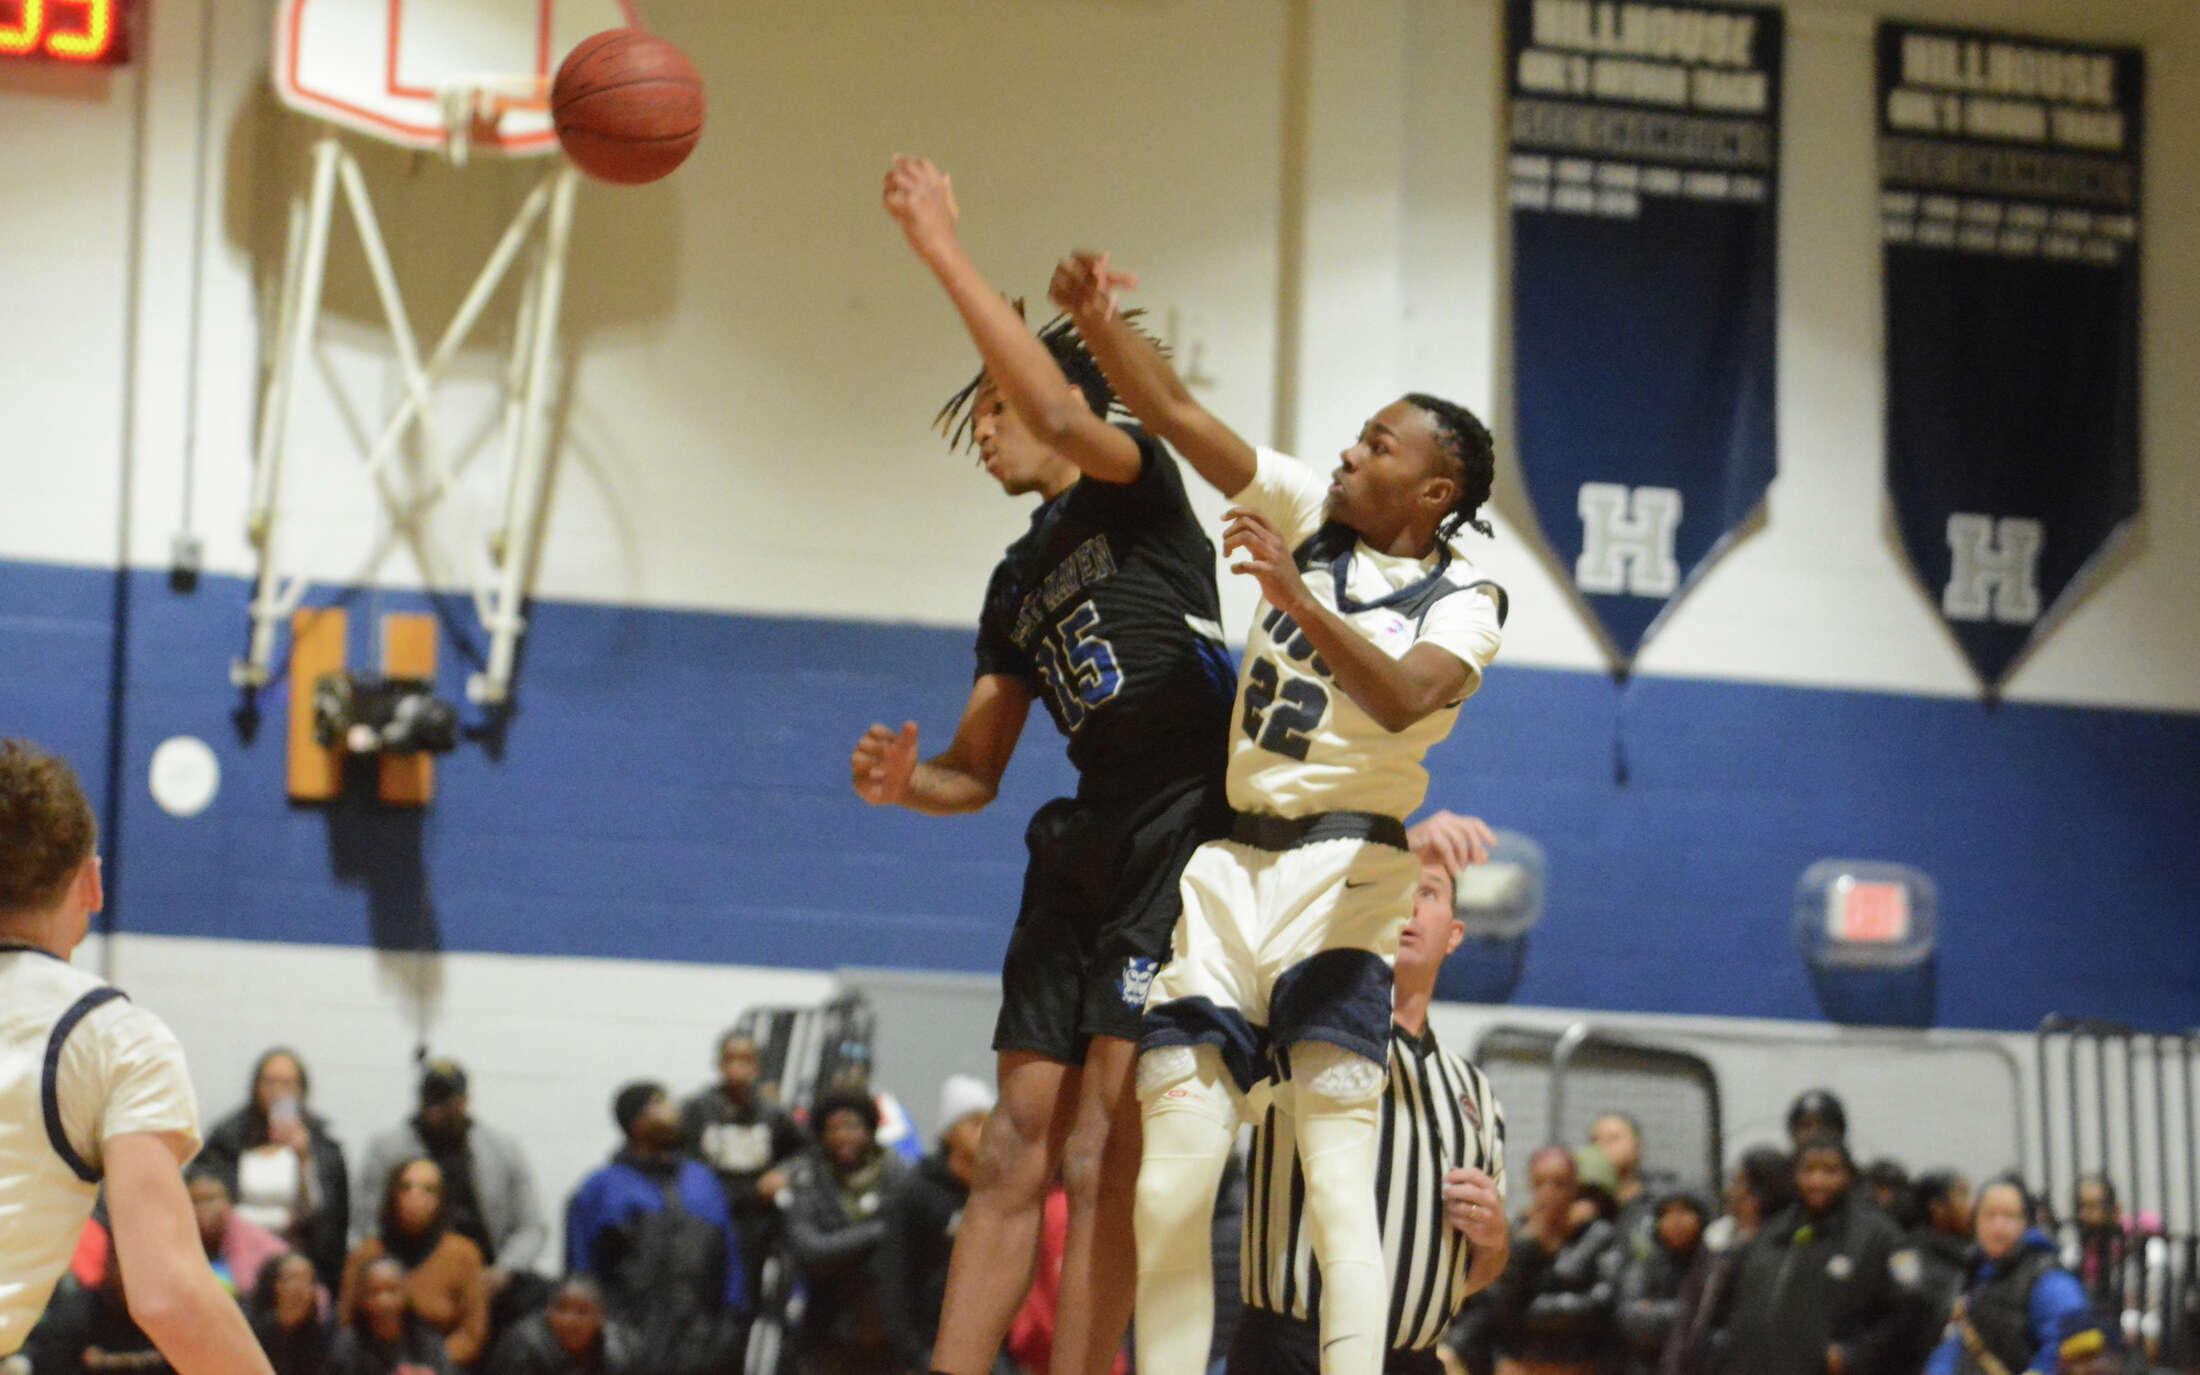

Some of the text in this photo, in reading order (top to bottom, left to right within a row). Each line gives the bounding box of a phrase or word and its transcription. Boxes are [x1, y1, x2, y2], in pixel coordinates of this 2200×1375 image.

[1576, 482, 1683, 598] H
[1943, 512, 2042, 624] H
[1036, 599, 1124, 732] 15
[1242, 656, 1328, 761] 22
